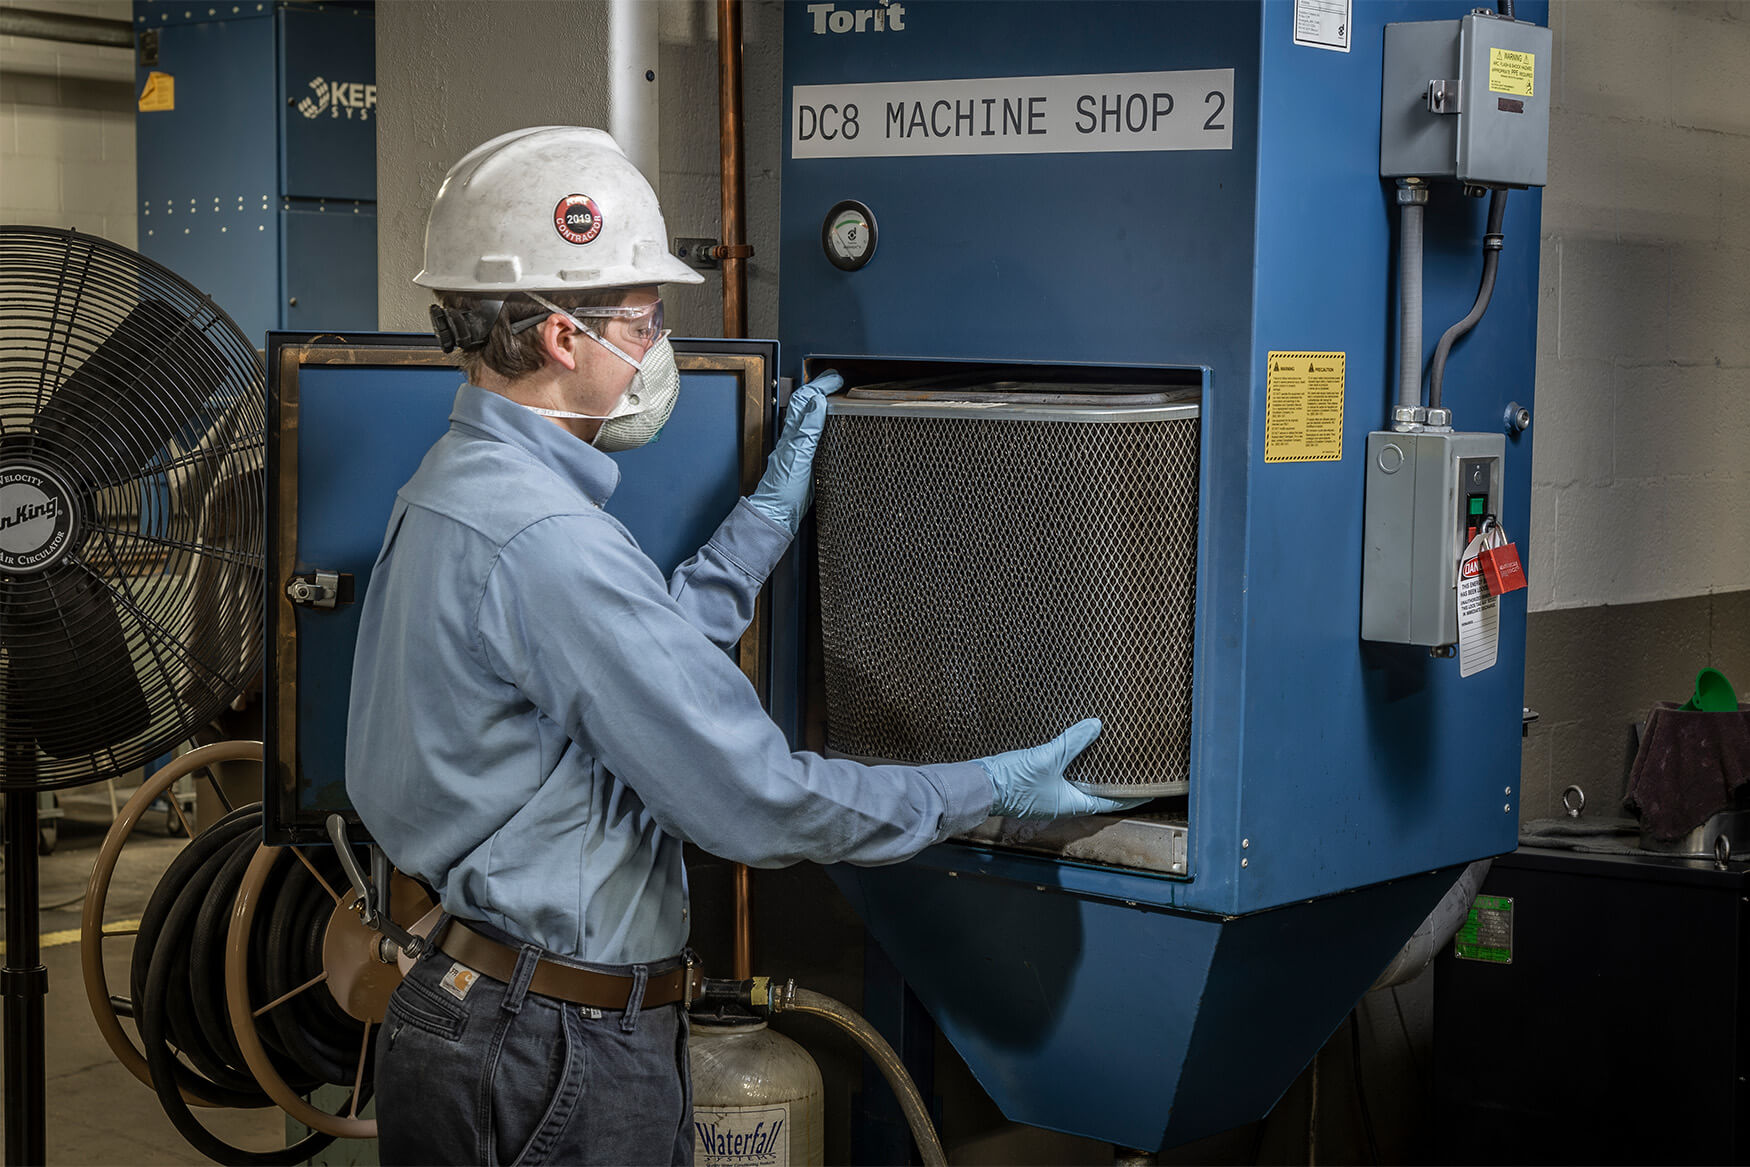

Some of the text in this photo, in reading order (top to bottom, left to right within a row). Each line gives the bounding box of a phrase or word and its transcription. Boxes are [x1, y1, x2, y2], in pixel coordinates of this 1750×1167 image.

[808, 0, 906, 35] Torit
[331, 106, 376, 121] SYS
[799, 90, 1226, 141] DC8 MACHINE SHOP 2
[556, 215, 602, 242] CONTRACTOR
[566, 213, 591, 224] 2019
[17, 530, 65, 566] CIRCULATOR
[1465, 561, 1481, 575] DAN
[695, 1119, 784, 1156] Waterfall
[703, 1154, 777, 1162] SYSTEMS
